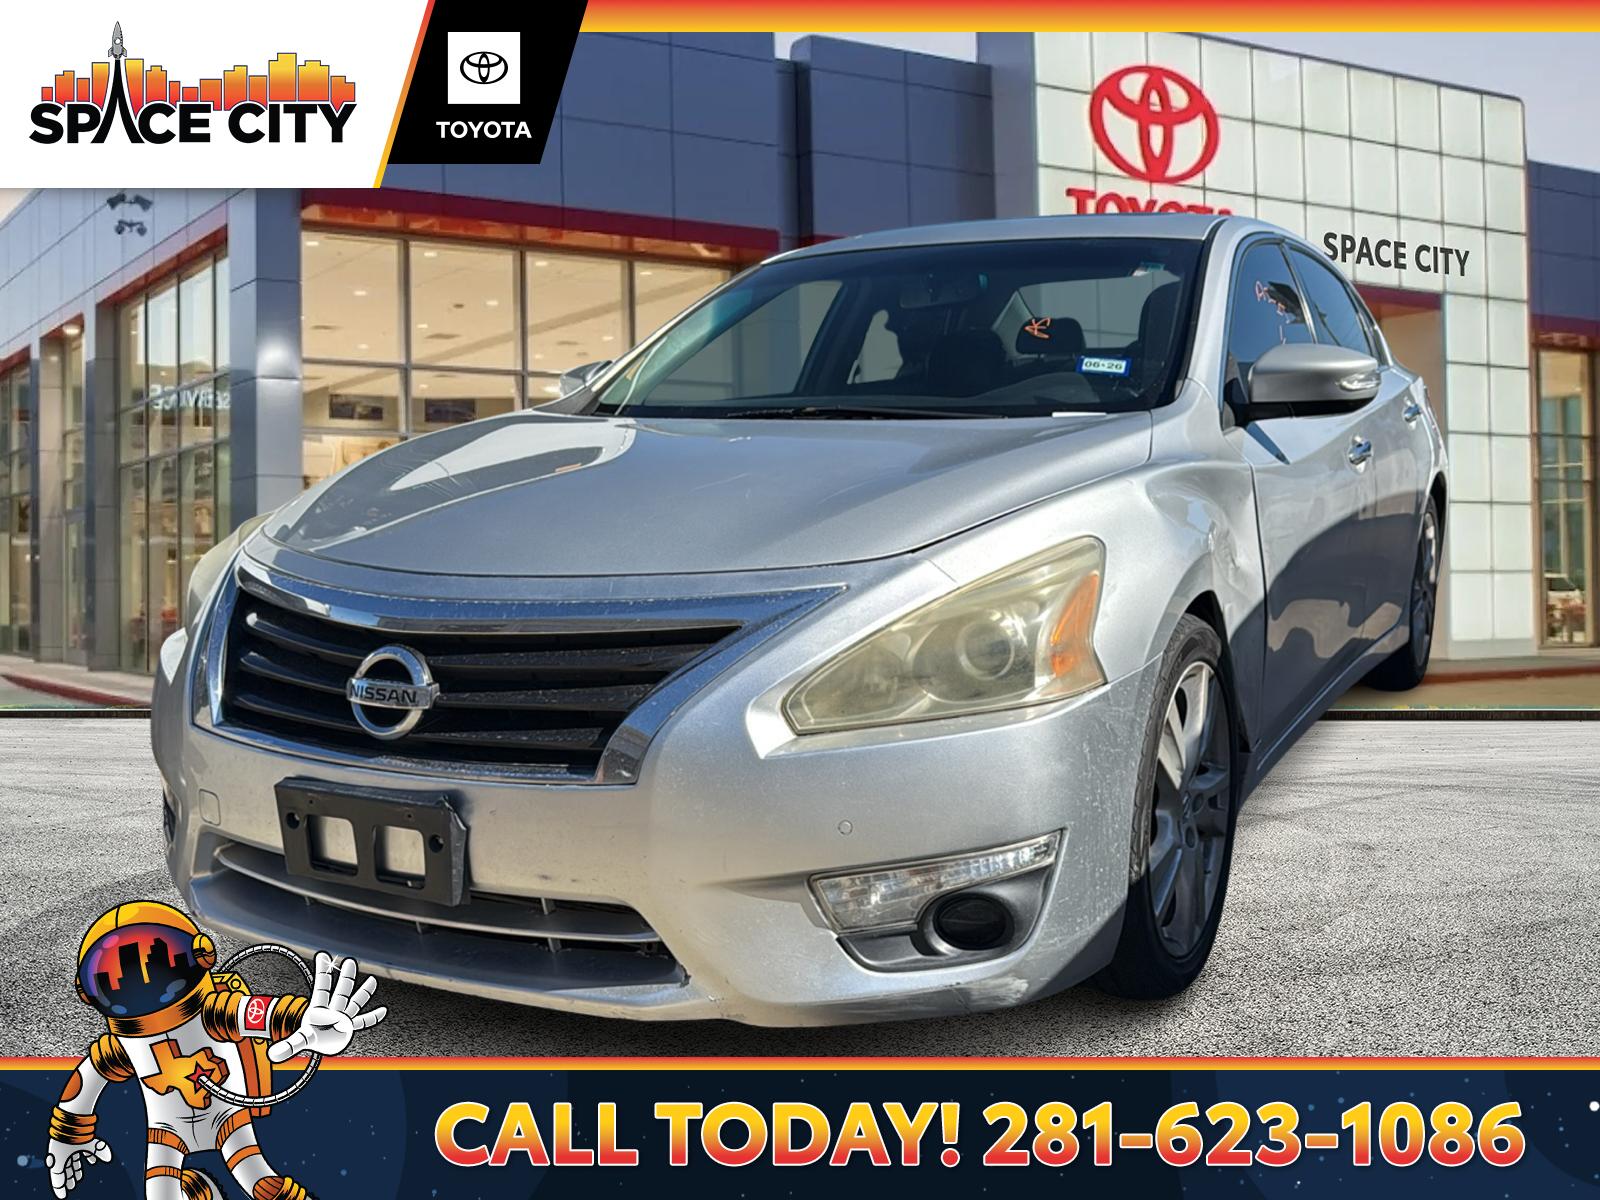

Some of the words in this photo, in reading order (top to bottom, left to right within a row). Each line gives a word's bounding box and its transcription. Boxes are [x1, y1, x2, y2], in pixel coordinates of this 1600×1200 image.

[1323, 231, 1408, 270] SPACE
[1414, 243, 1470, 277] CITY
[349, 683, 418, 704] NISSAN
